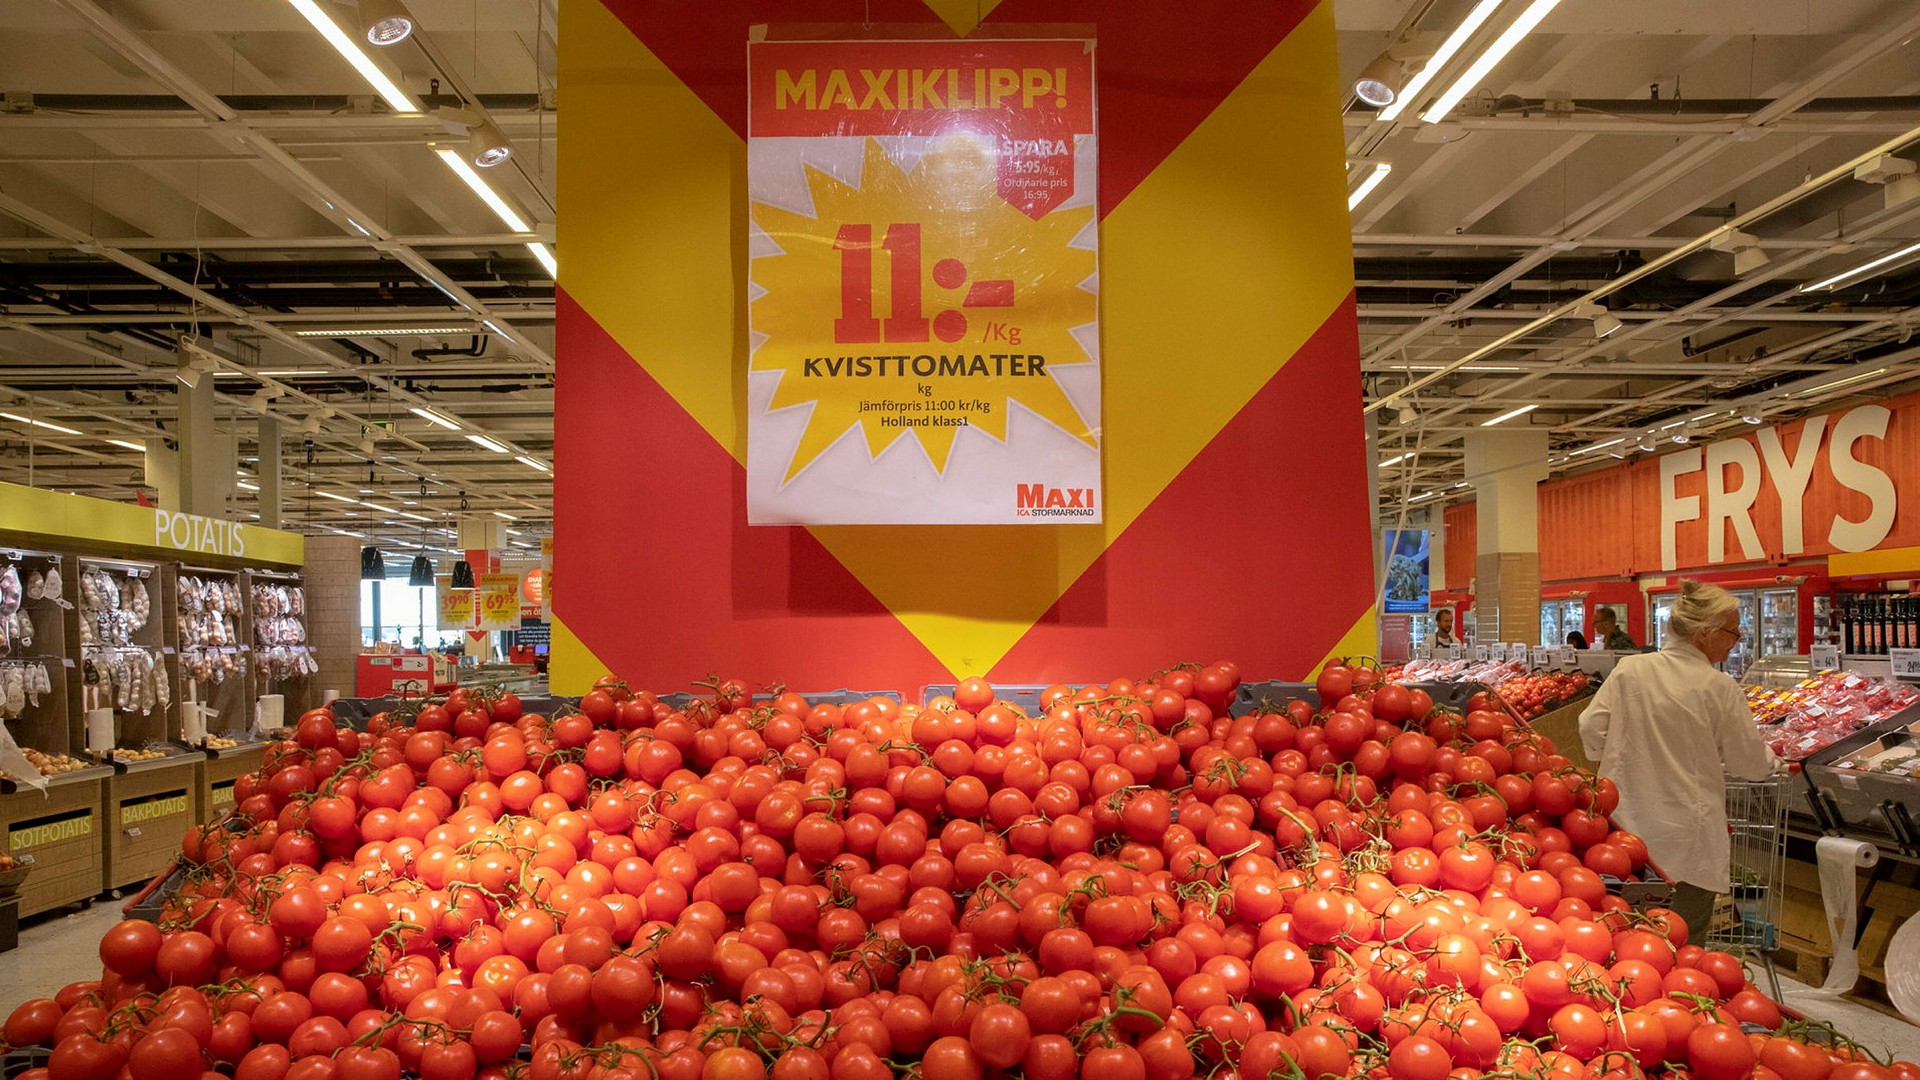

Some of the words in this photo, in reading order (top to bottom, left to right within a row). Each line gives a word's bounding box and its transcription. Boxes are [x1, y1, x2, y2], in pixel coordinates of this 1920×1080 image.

[775, 67, 1067, 111] MAXIKLIPP!
[1002, 140, 1069, 157] SPARA
[1003, 178, 1048, 189] Ordinarie
[1050, 177, 1068, 189] pris
[1022, 190, 1048, 199] 16:95
[833, 223, 1015, 343] 11:-
[983, 321, 1022, 345] /Kg
[804, 355, 1046, 377] KVISTTOMATER
[917, 383, 932, 395] kg
[858, 400, 921, 412] Jämförpris
[925, 401, 955, 411] 11:00
[958, 400, 990, 412] kr/kg
[881, 416, 929, 427] Holland
[932, 416, 968, 427] klass1
[1659, 405, 1897, 571] FRYS
[1017, 508, 1031, 516] ICA
[1032, 508, 1095, 516] STORMARKNAD
[155, 509, 245, 557] POTATIS
[123, 797, 186, 823] BAKPOTATIS
